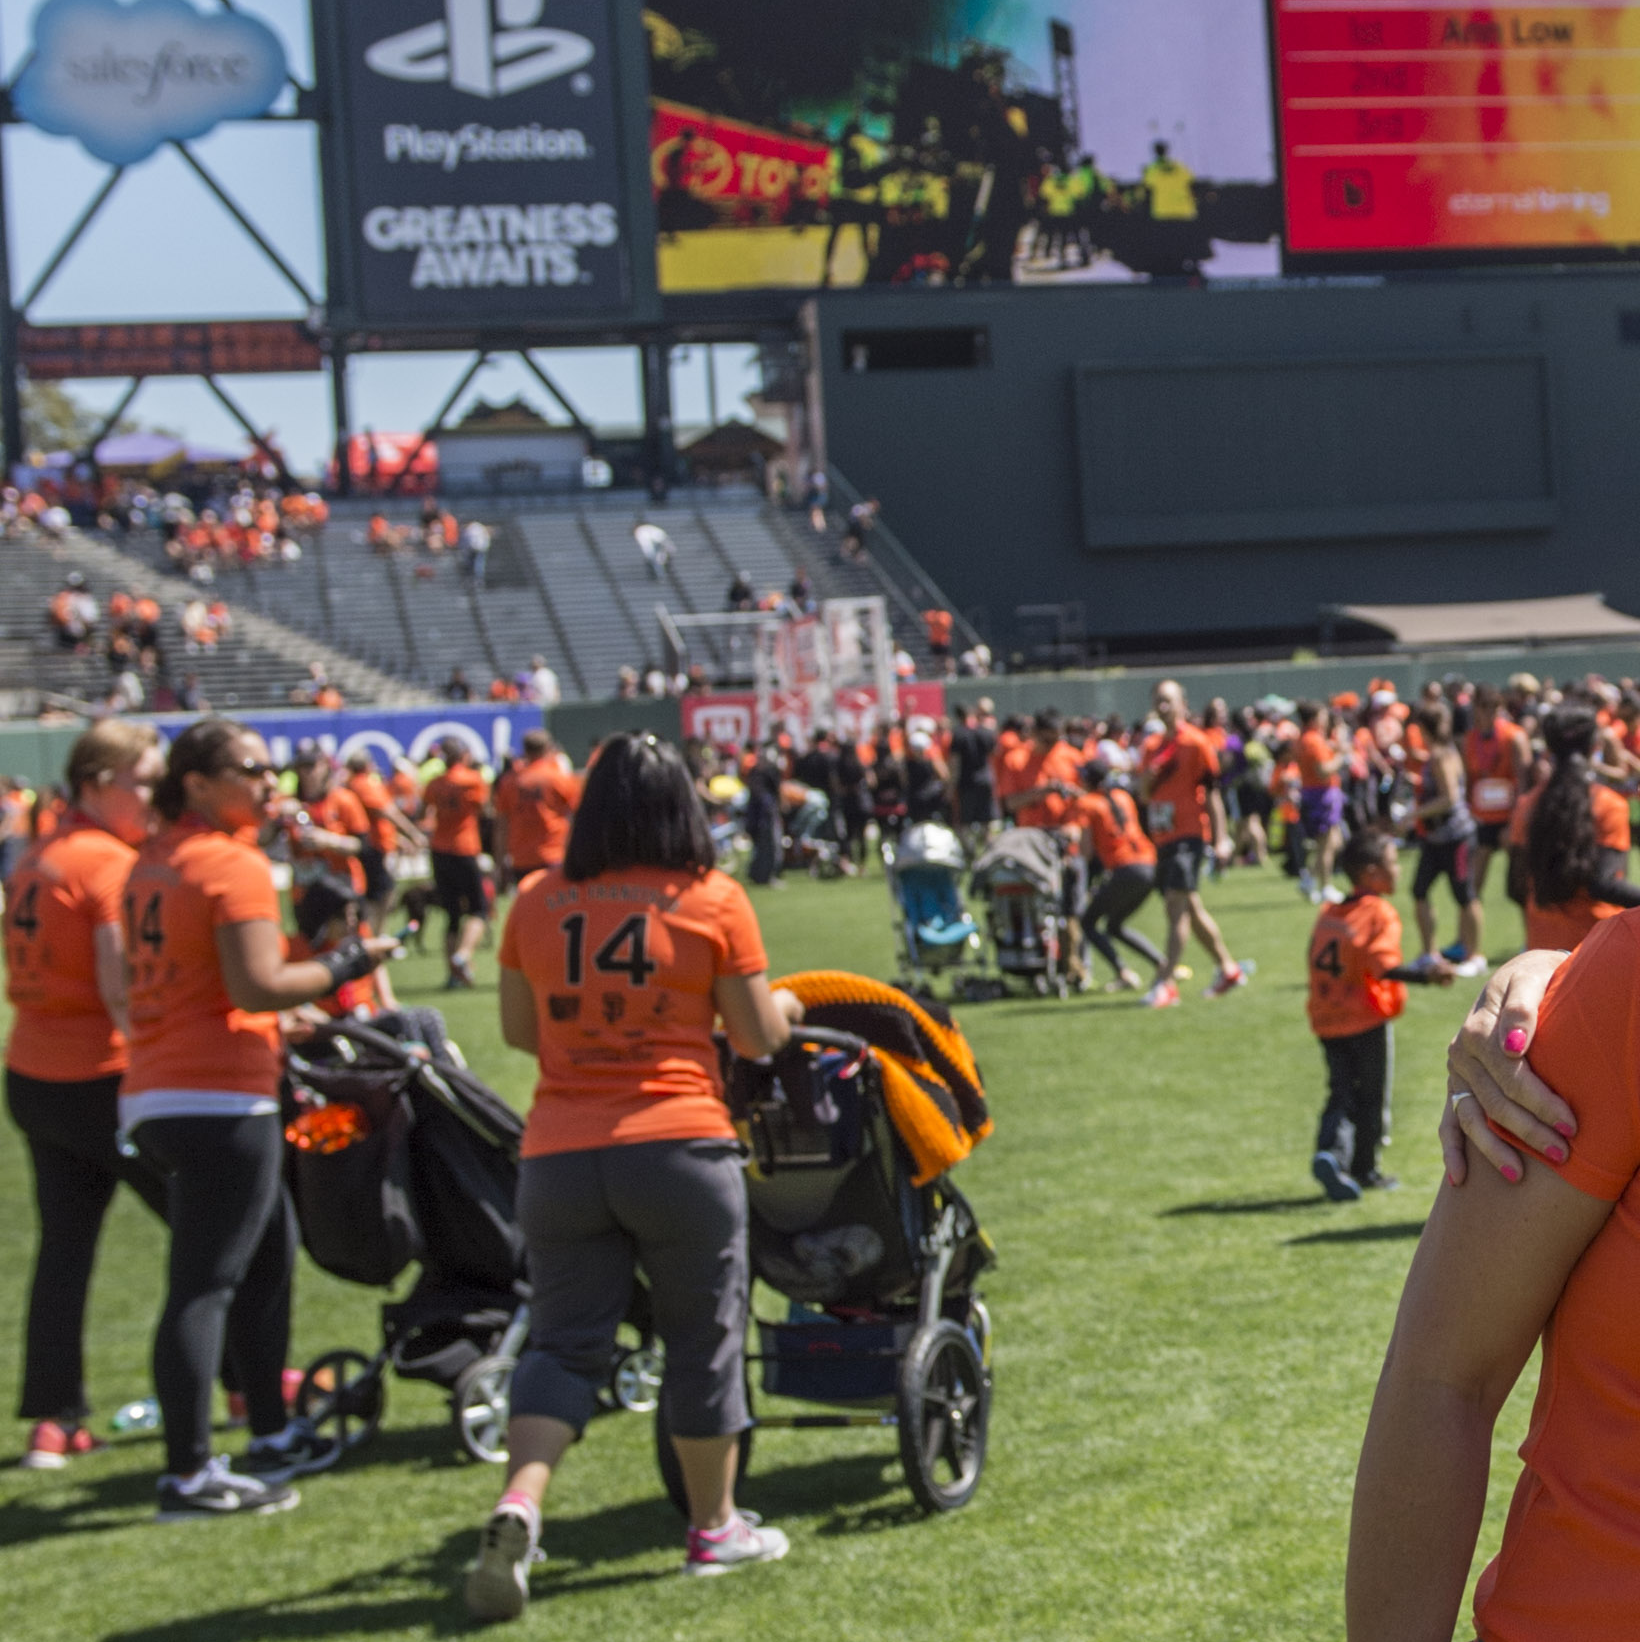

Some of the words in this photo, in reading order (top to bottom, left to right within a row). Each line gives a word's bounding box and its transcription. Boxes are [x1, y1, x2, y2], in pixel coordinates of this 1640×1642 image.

[1510, 17, 1575, 46] Low
[384, 124, 590, 170] PlayStation
[364, 205, 619, 252] GREATNESS
[411, 244, 580, 290] AWAITS
[560, 911, 657, 988] 14
